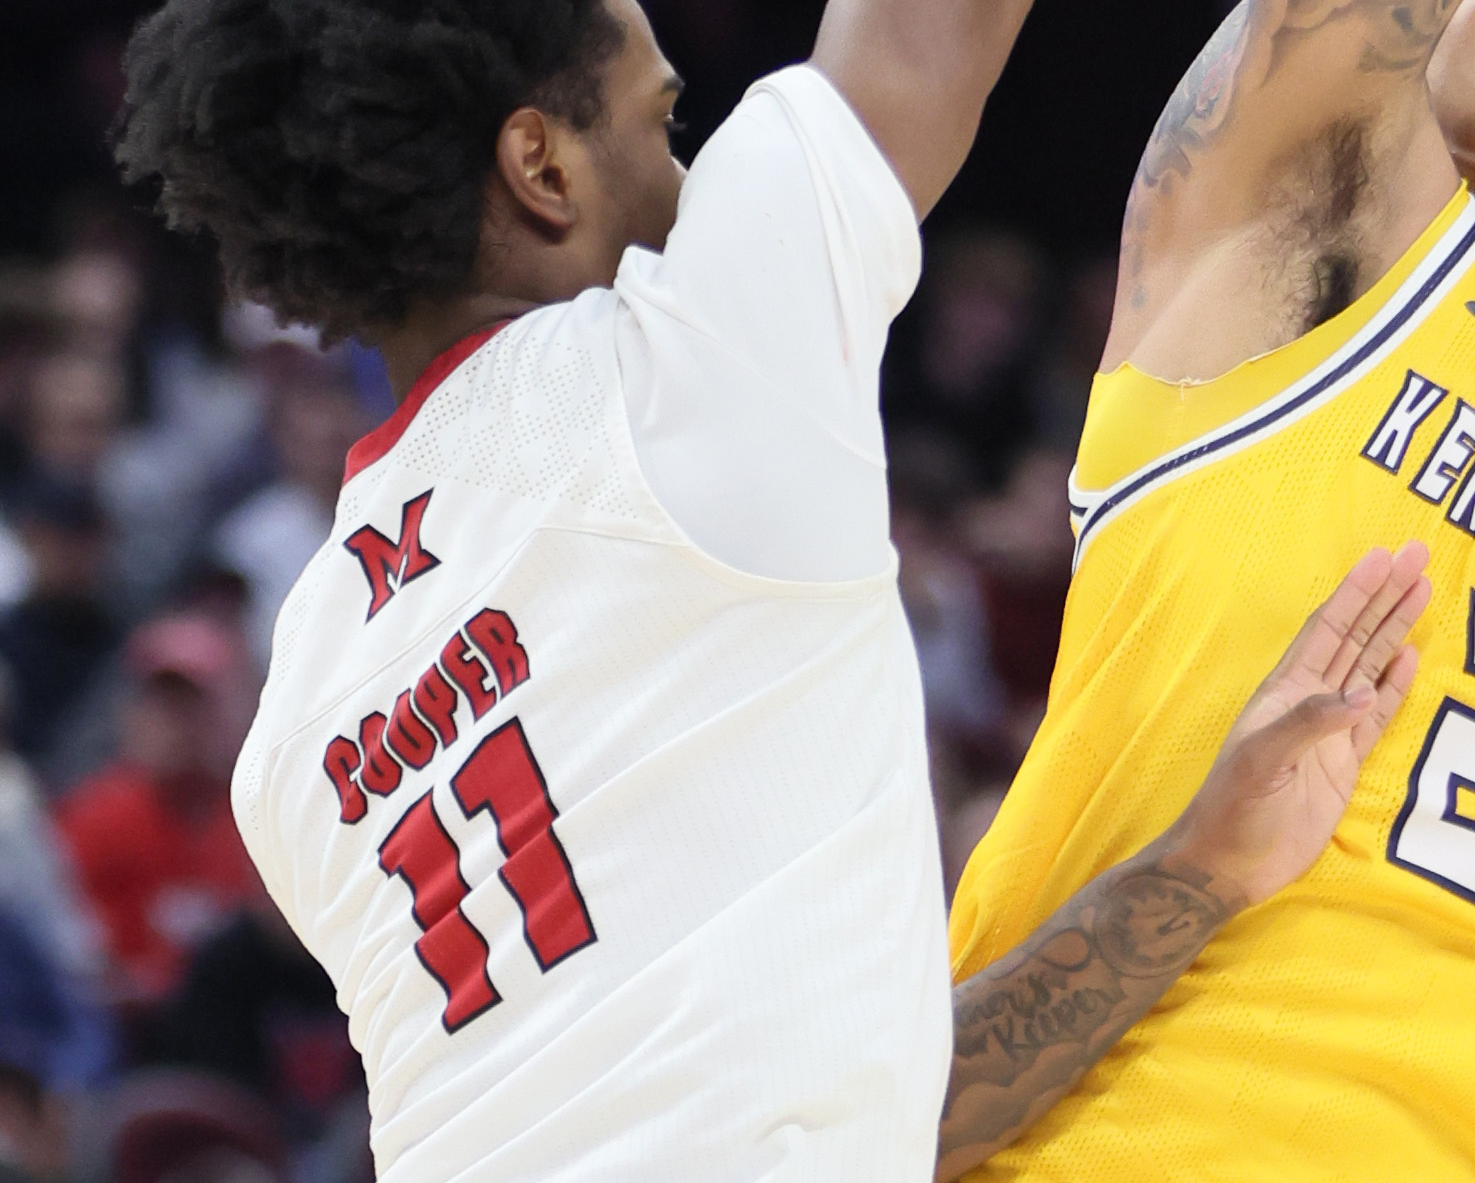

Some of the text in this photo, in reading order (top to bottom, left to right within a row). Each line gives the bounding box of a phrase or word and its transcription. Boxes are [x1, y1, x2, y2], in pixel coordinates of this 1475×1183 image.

[342, 486, 443, 625] M
[323, 607, 531, 826] COOPER
[377, 715, 598, 1037] 11
